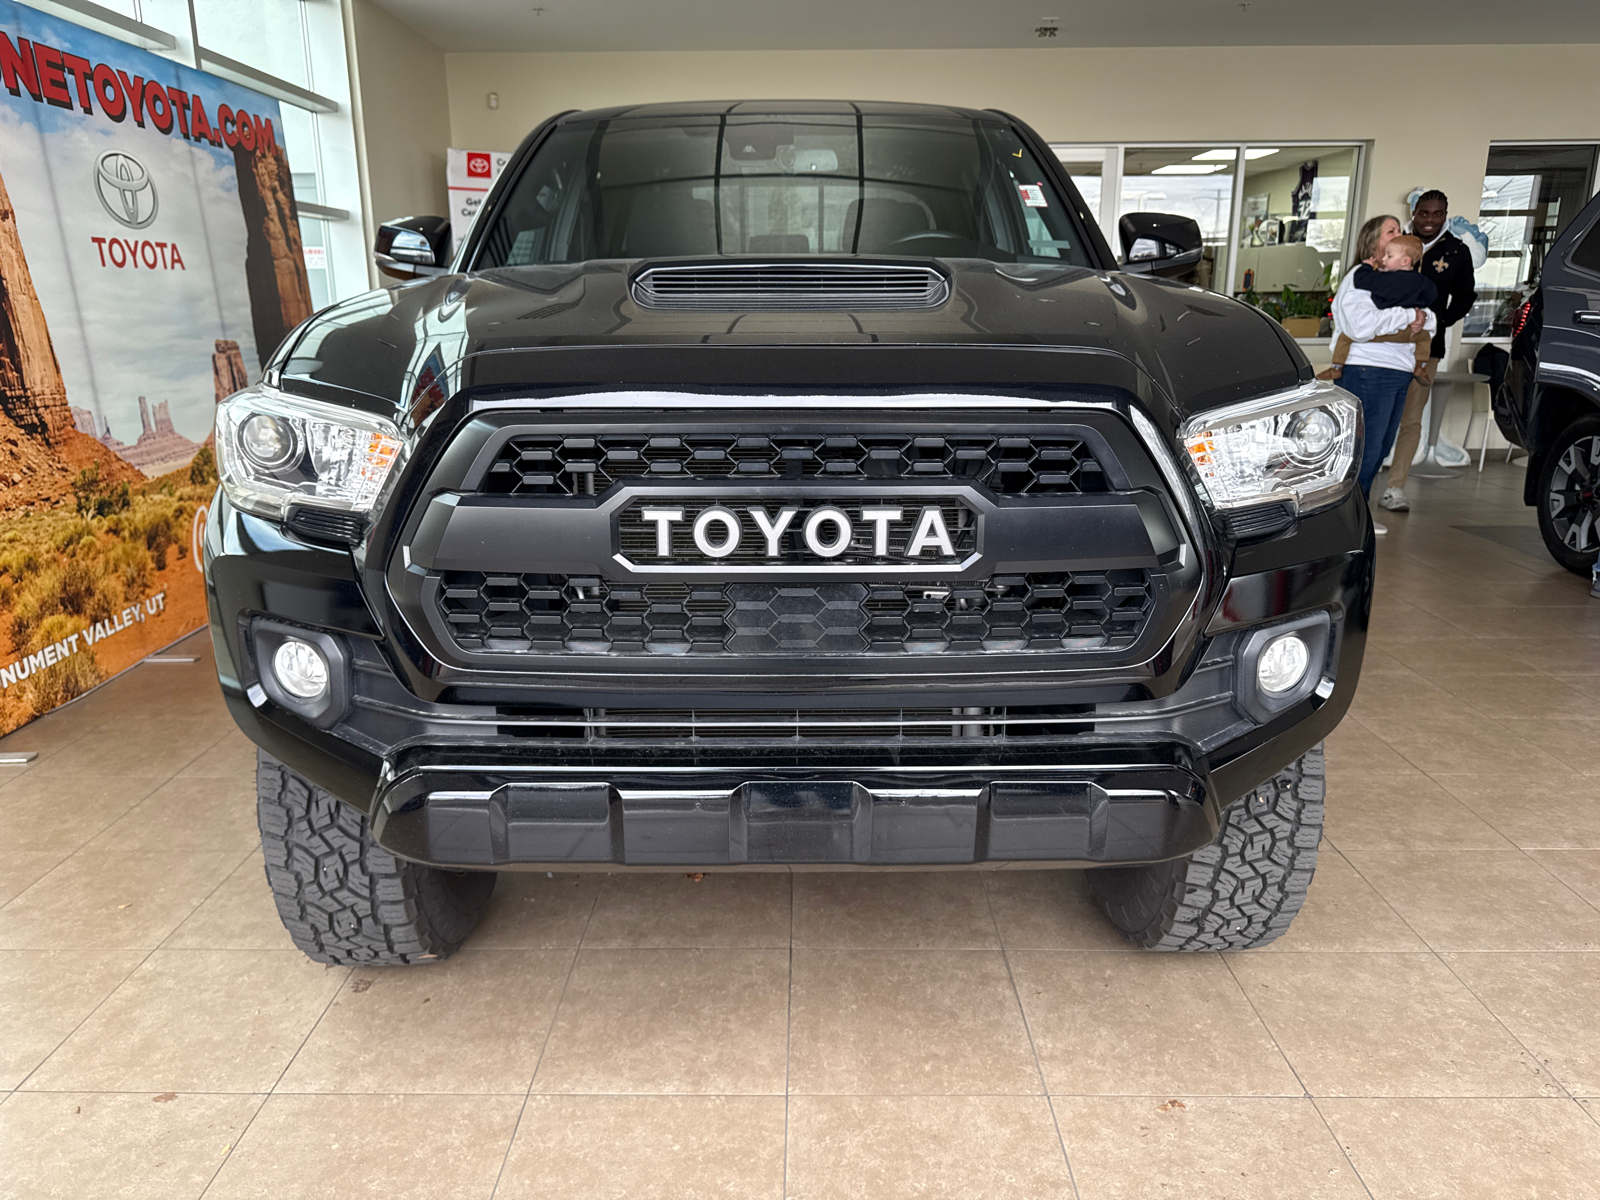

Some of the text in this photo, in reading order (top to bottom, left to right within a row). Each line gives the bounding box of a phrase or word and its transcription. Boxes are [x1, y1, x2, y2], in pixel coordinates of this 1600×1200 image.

[0, 30, 277, 157] NETOYOTA.COM
[91, 236, 186, 271] TOYOTA
[641, 505, 956, 558] TOYOTA
[0, 593, 165, 689] NUMENT VALLEY, UT
